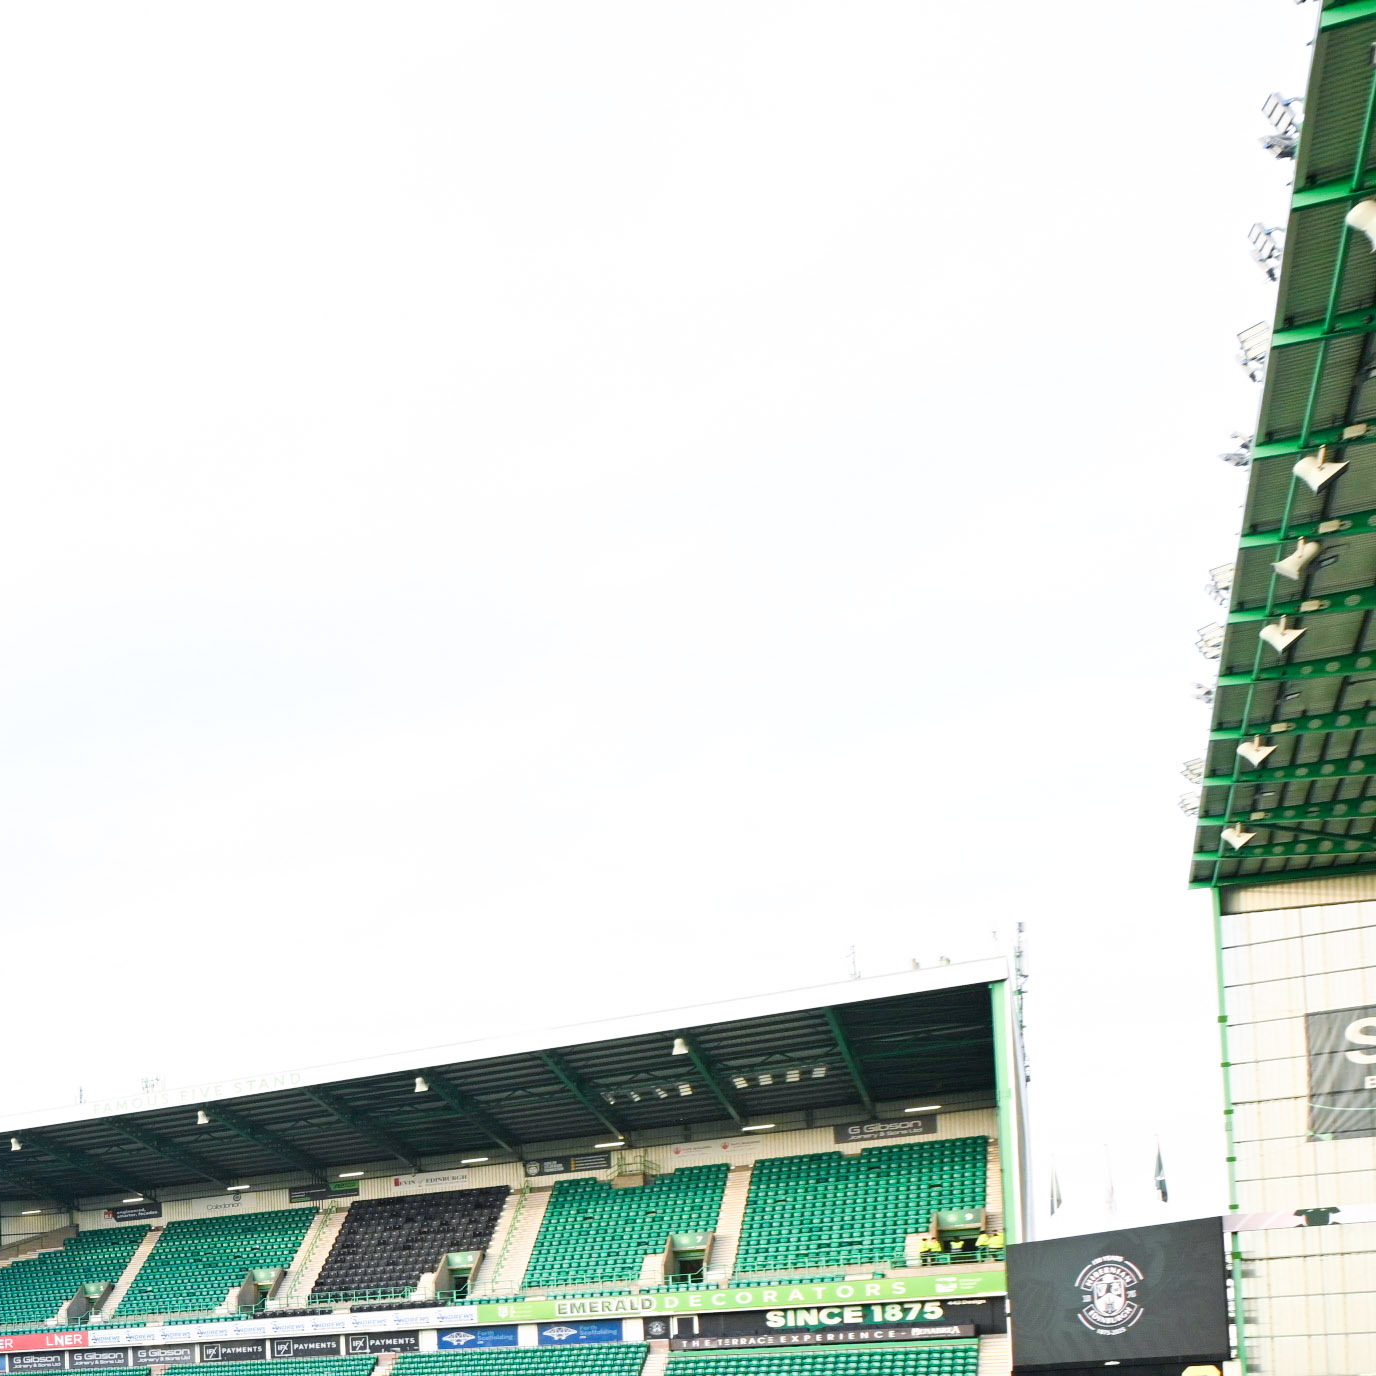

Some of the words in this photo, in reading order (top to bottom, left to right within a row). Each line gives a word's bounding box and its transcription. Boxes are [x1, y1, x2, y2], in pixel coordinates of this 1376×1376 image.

[848, 1126, 860, 1134] G
[863, 1120, 922, 1133] Gibson
[1085, 1267, 1132, 1287] HIBERNIAN
[556, 1296, 656, 1316] EMERALD
[664, 1280, 906, 1310] DECORATORS
[765, 1306, 863, 1328] SINCE
[871, 1302, 944, 1323] 1875
[1088, 1306, 1133, 1324] EDINBURGH
[580, 1328, 618, 1336] Scaffolding
[46, 1334, 82, 1346] LNER
[370, 1337, 415, 1346] PAYMENTS
[682, 1338, 711, 1348] THE
[718, 1336, 774, 1346] TERRACE
[780, 1330, 896, 1344] EXPERIENCE
[222, 1346, 262, 1354] PAYMENTS
[294, 1341, 336, 1350] PAYMENTS
[84, 1352, 124, 1360] Gibson
[138, 1350, 146, 1358] G
[148, 1348, 190, 1356] Gibson
[13, 1356, 21, 1364] G
[23, 1355, 60, 1363] Gibson
